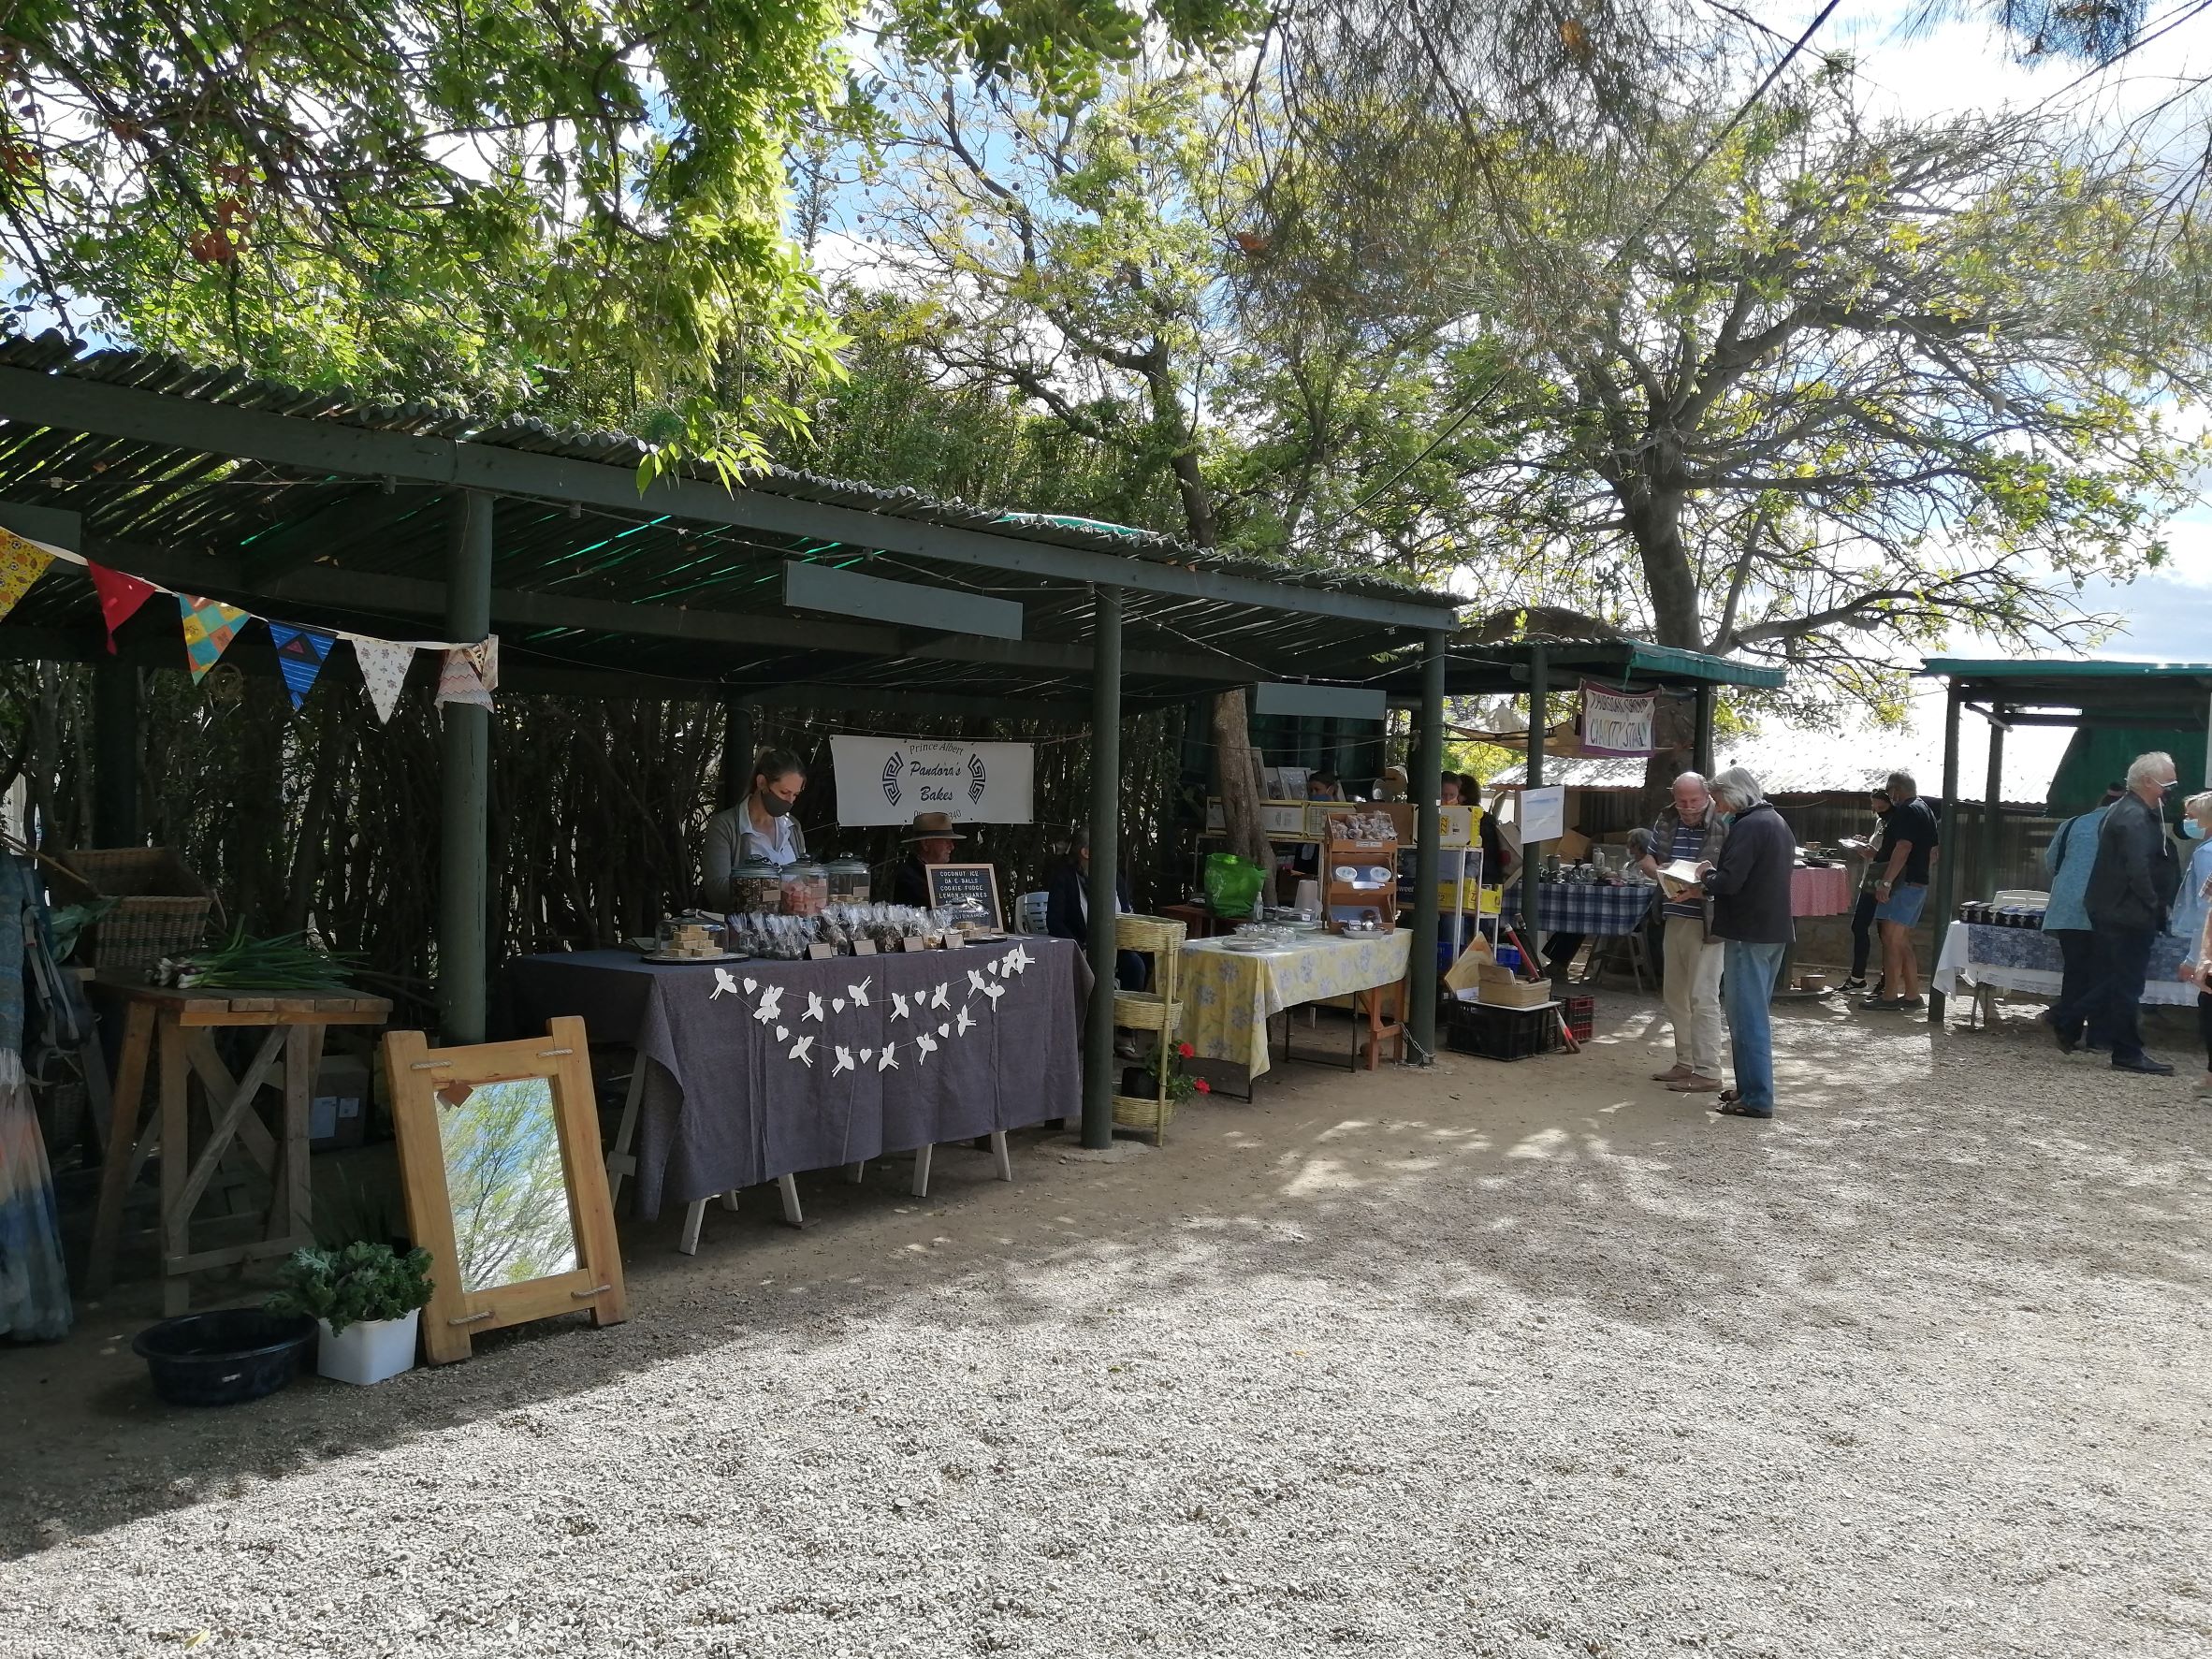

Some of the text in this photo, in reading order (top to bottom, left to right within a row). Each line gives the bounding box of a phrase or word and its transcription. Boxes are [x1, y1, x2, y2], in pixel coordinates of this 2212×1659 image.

[939, 743, 964, 756] Albert
[910, 760, 961, 777] Pandora's
[920, 785, 953, 801] Bakes
